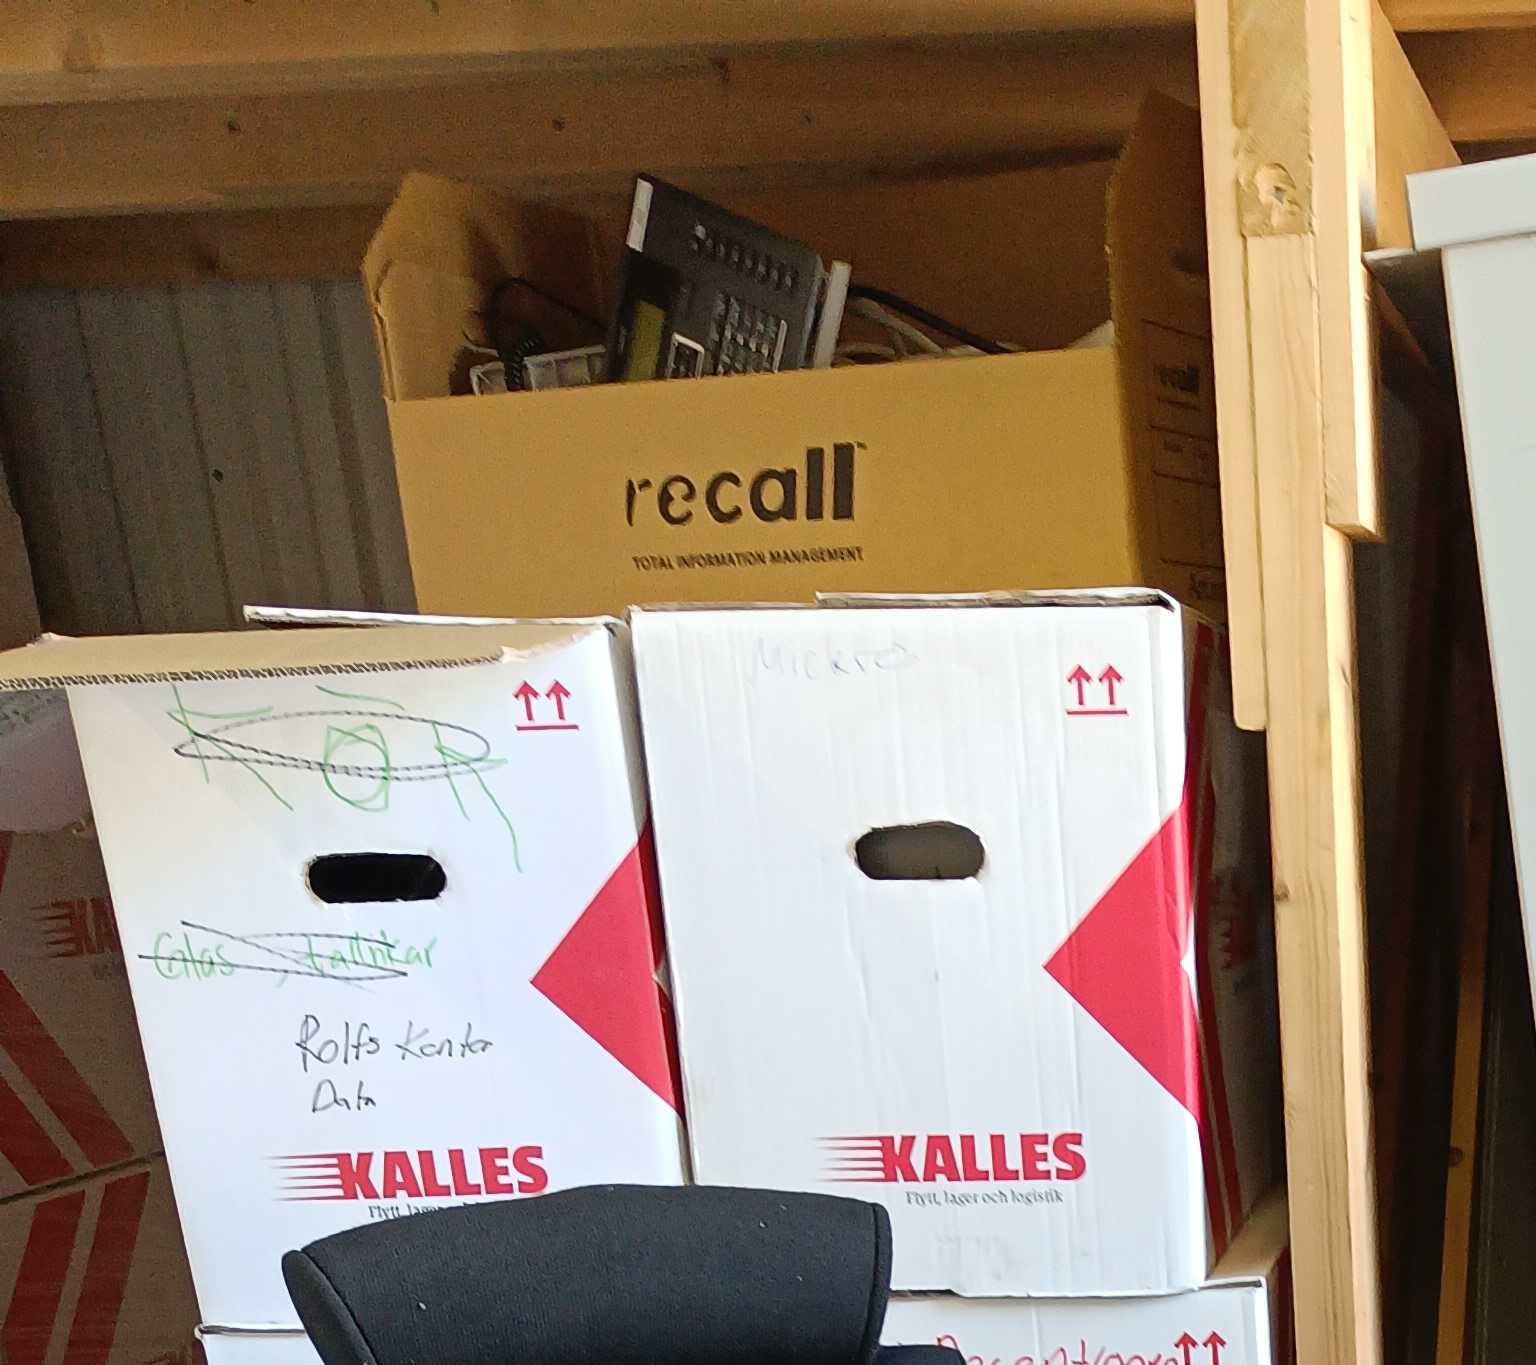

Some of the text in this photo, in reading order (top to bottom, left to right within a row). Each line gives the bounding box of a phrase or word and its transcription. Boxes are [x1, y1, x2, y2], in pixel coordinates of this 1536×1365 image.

[625, 441, 855, 527] recall
[632, 546, 865, 572] TOTAL INFORMATION MANAGEMENT
[294, 1014, 380, 1073] Rolfs
[335, 1145, 549, 1201] KALLES
[880, 1132, 1087, 1183] KALLES
[979, 1187, 1009, 1203] och
[1010, 1187, 1064, 1207] logistik
